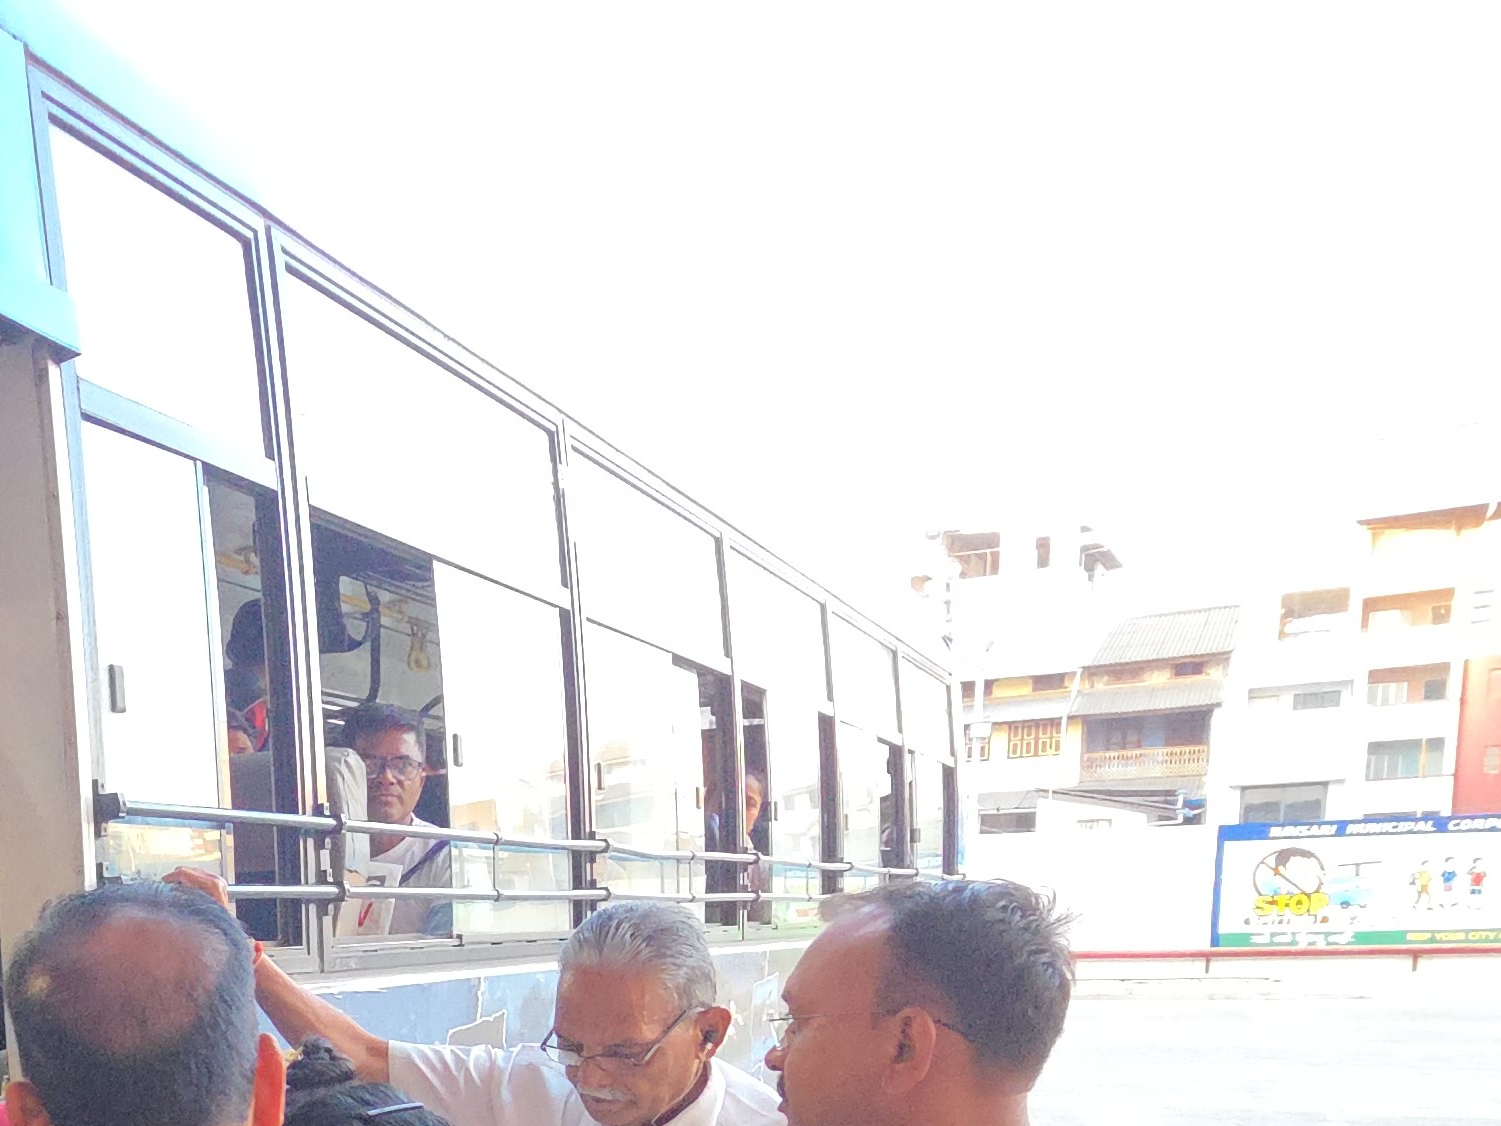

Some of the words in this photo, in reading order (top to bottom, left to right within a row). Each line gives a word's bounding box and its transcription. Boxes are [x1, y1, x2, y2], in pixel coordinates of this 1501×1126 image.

[1345, 820, 1437, 834] MUNICIPAL
[1448, 818, 1501, 831] CORP
[1253, 892, 1330, 917] STOP
[1468, 931, 1497, 940] CITY
